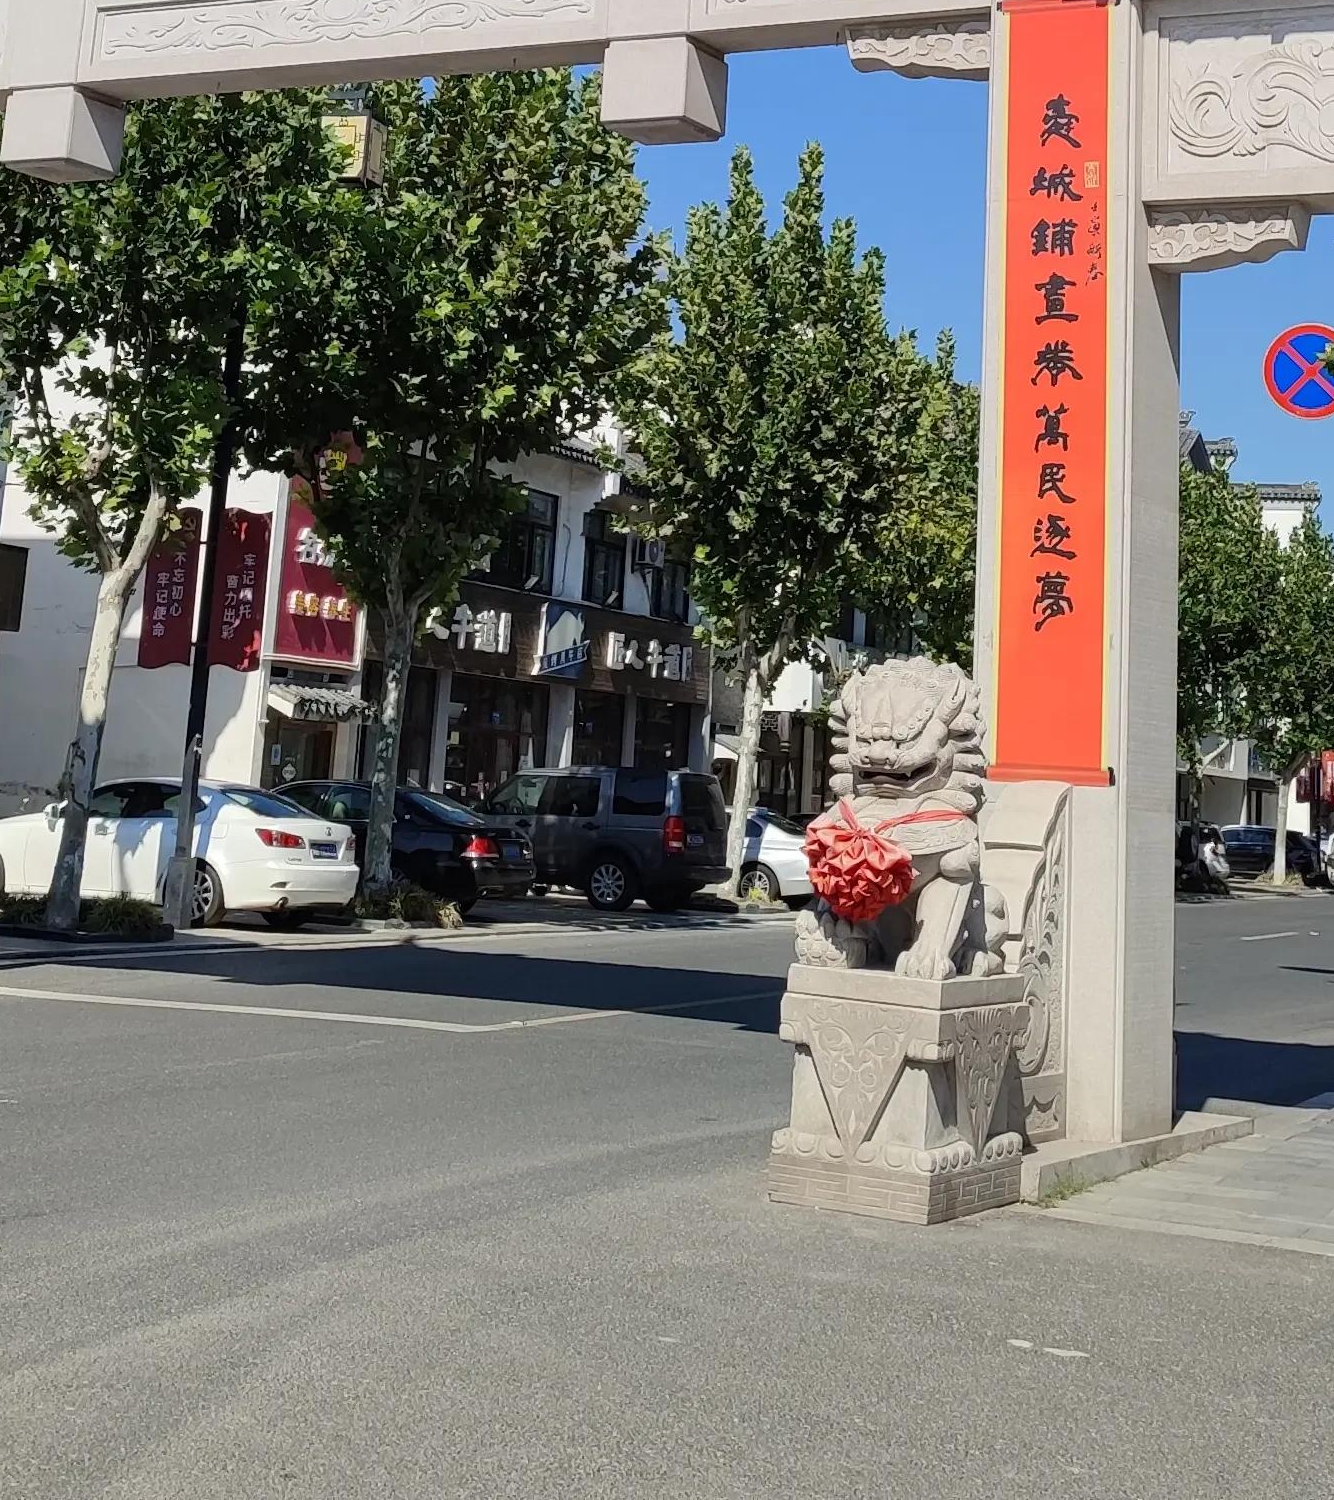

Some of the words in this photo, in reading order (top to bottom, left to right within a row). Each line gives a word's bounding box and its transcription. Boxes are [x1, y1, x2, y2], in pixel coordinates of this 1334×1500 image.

[152, 572, 171, 638] 牢记使命
[169, 551, 187, 617] 不忘初心
